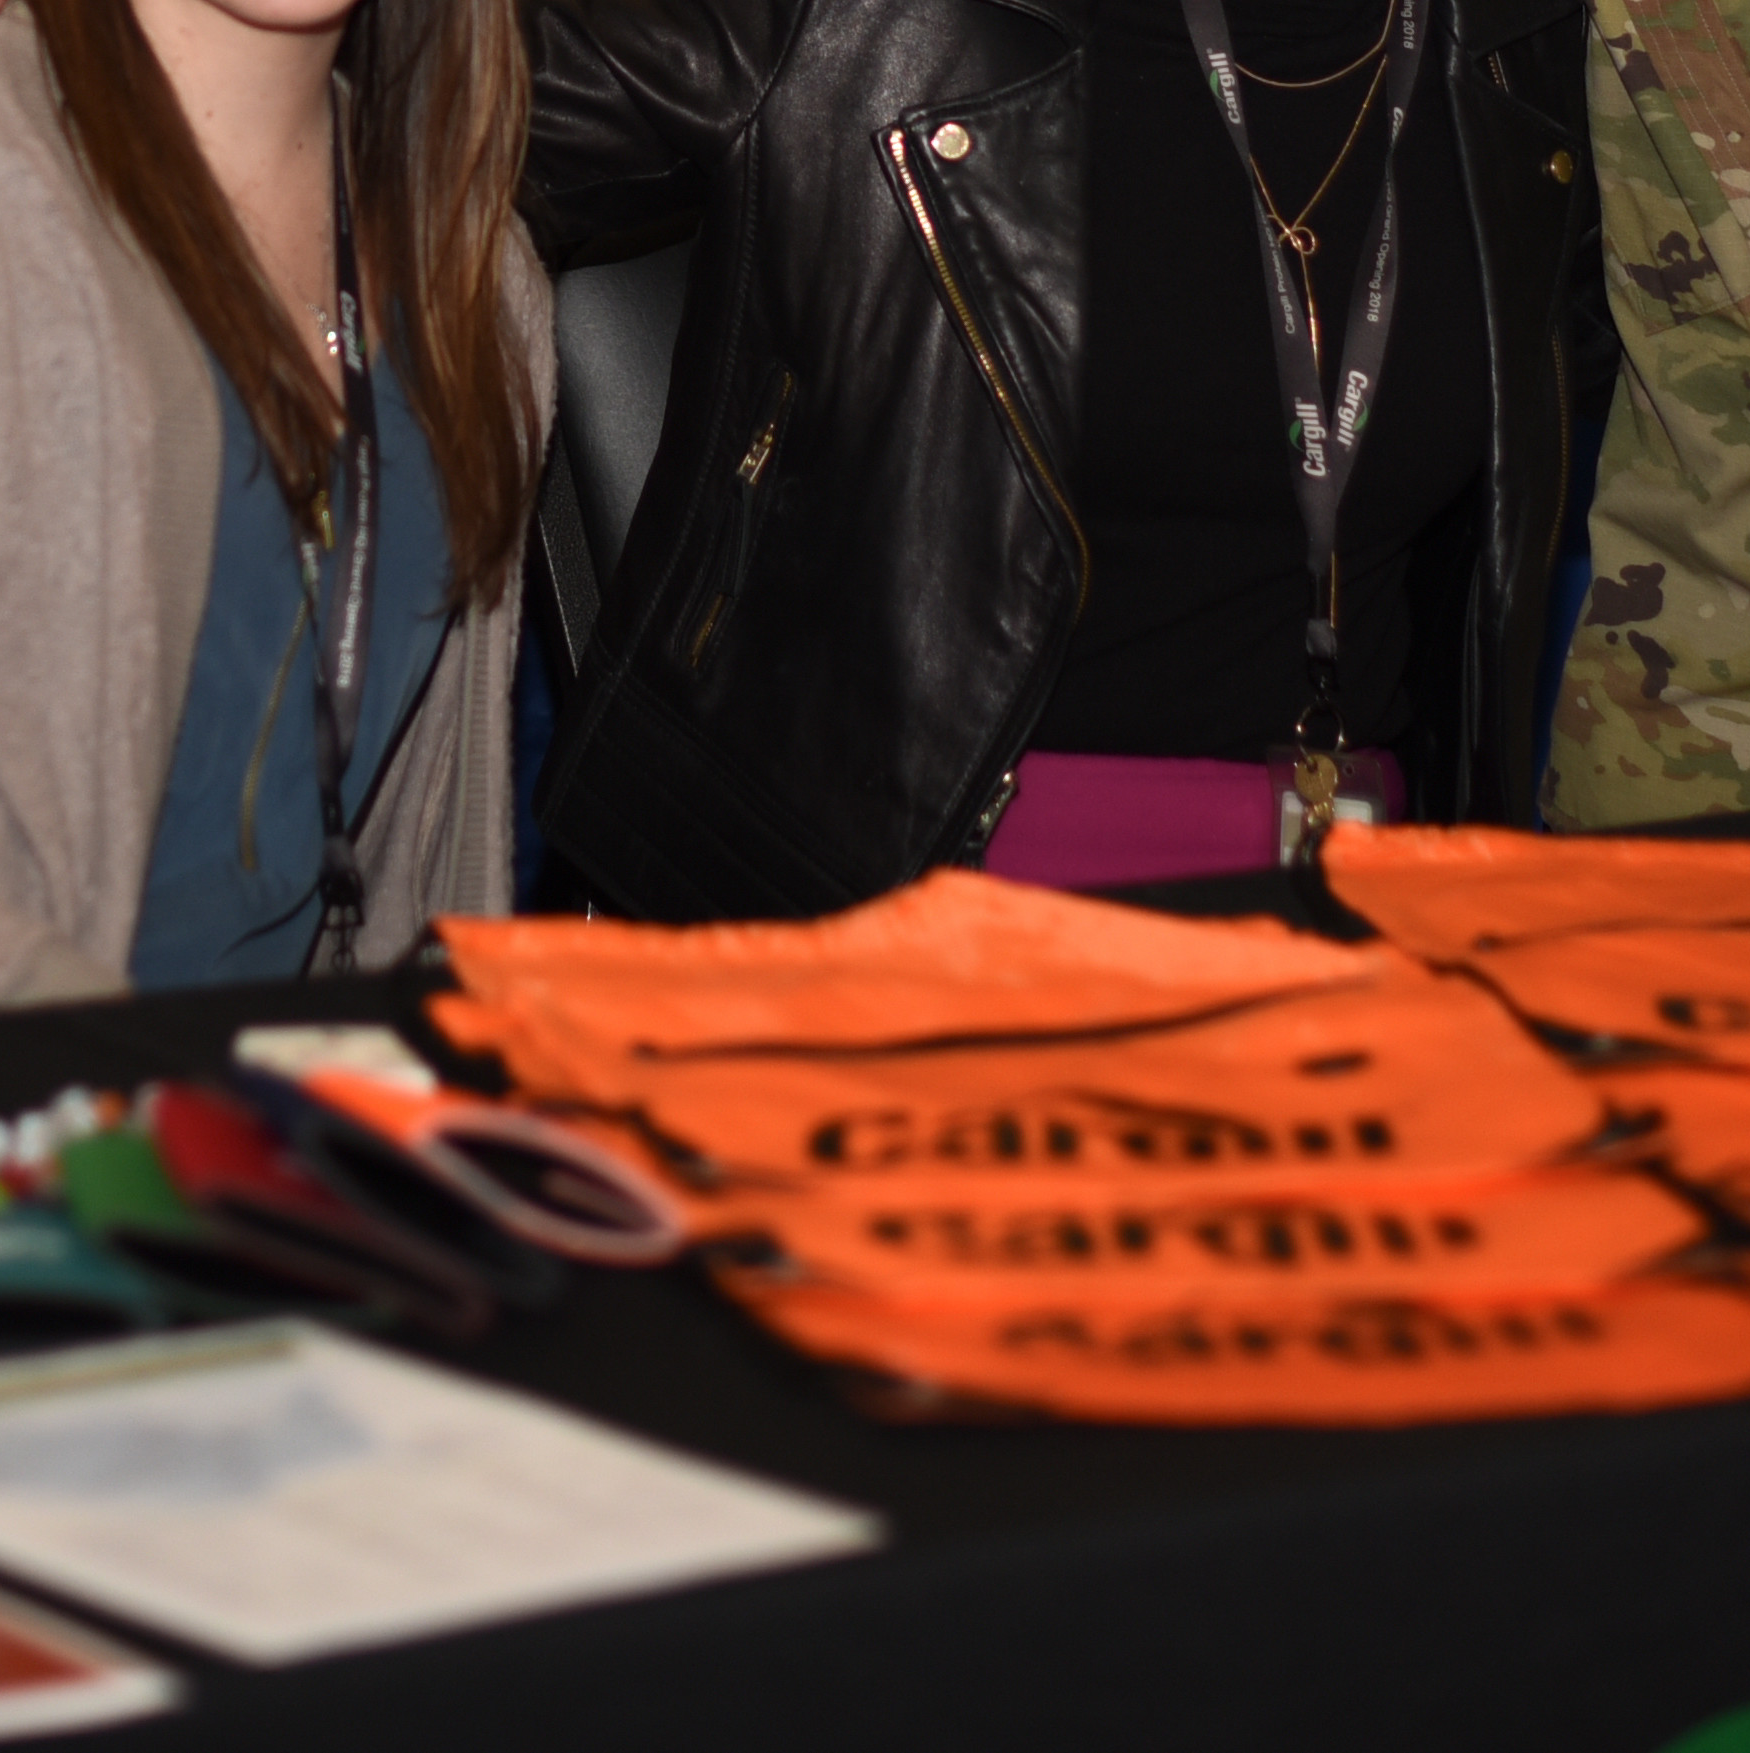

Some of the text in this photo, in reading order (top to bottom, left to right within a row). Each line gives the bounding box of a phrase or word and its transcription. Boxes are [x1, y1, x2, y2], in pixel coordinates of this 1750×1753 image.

[1403, 21, 1415, 49] 2018
[1208, 52, 1242, 125] Cargill
[1369, 243, 1391, 289] Opening
[1278, 294, 1296, 334] Cargill
[1367, 292, 1382, 322] 2018
[1337, 370, 1369, 446] Cargill
[1292, 402, 1327, 477] Cargill
